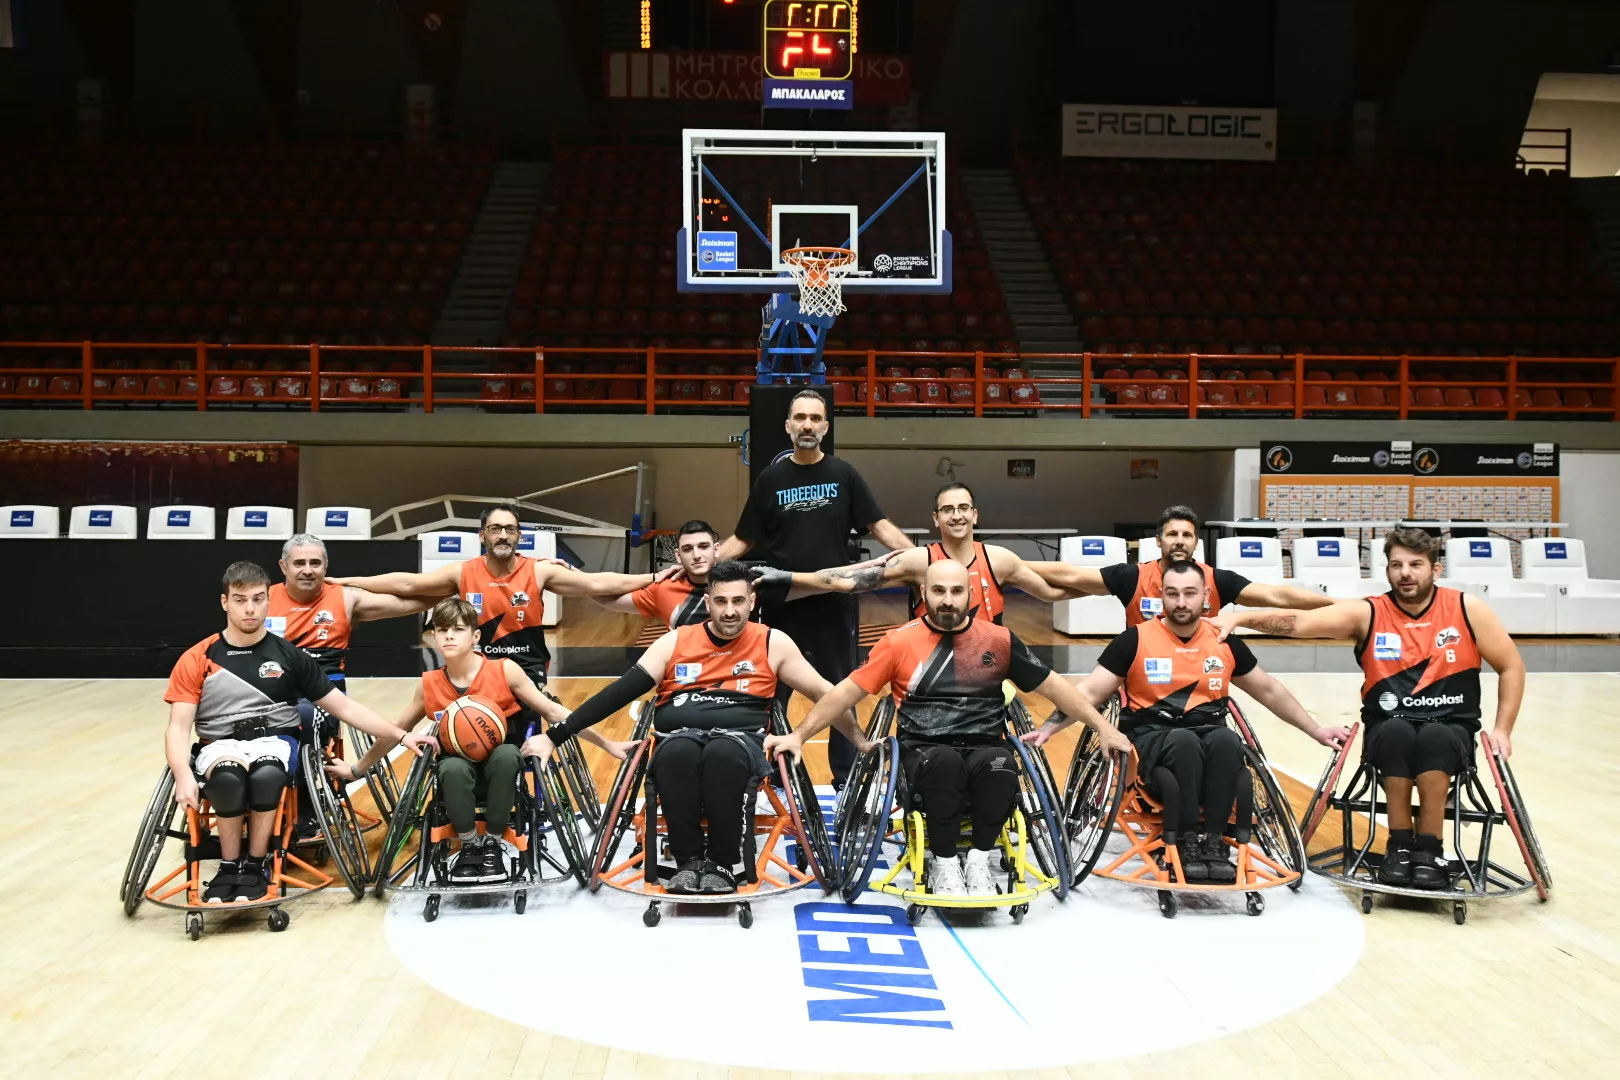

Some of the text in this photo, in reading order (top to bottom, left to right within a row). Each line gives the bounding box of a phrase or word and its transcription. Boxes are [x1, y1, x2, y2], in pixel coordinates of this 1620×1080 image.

[771, 88, 845, 100] ΜΠΑΚΑΛΑΡΟΣ
[701, 238, 734, 247] Stoiximan
[1332, 454, 1370, 463] Stoiximan
[1477, 456, 1514, 465] Stoiximan
[776, 482, 839, 505] THREEGUYS
[517, 611, 525, 621] 9
[485, 645, 530, 654] Coloplast
[1445, 649, 1456, 662] 6
[735, 679, 750, 692] 12
[1208, 677, 1222, 690] 23
[1402, 694, 1464, 707] Coloplast
